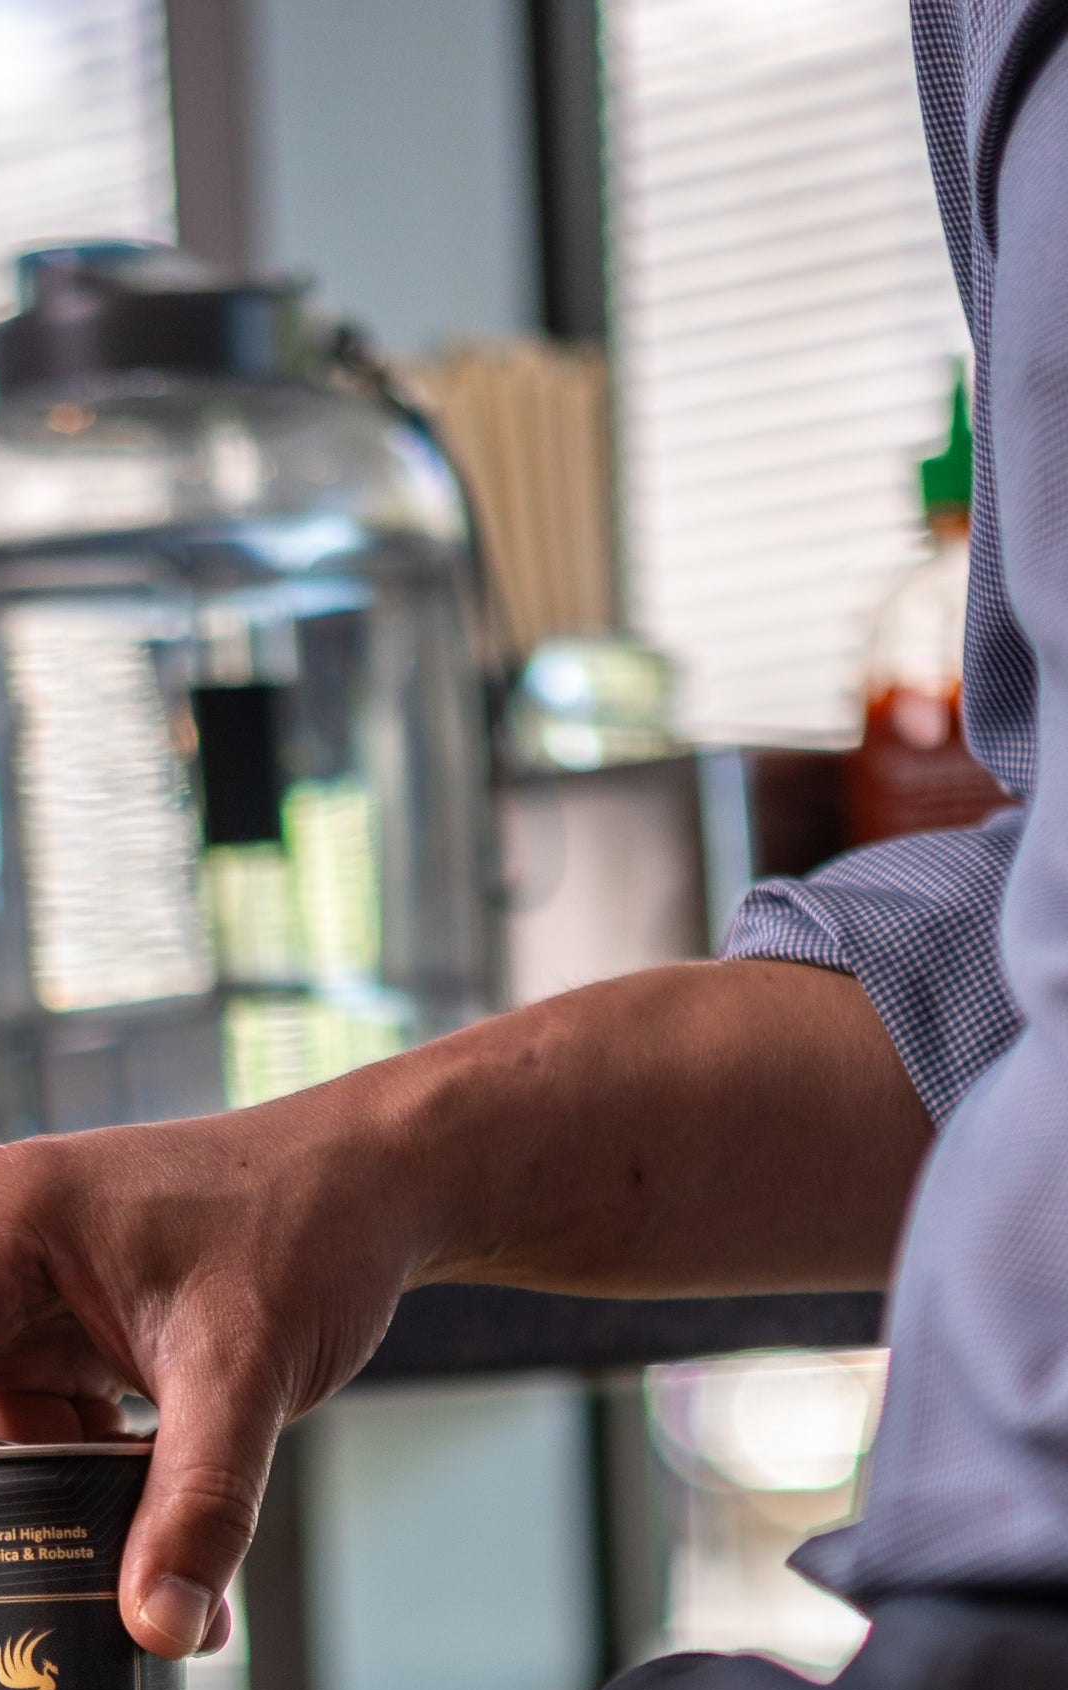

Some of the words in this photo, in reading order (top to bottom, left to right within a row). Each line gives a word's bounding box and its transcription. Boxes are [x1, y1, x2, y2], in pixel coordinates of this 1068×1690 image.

[20, 1525, 88, 1542] Highlands
[23, 1547, 34, 1561] &
[38, 1547, 94, 1560] Robusta
